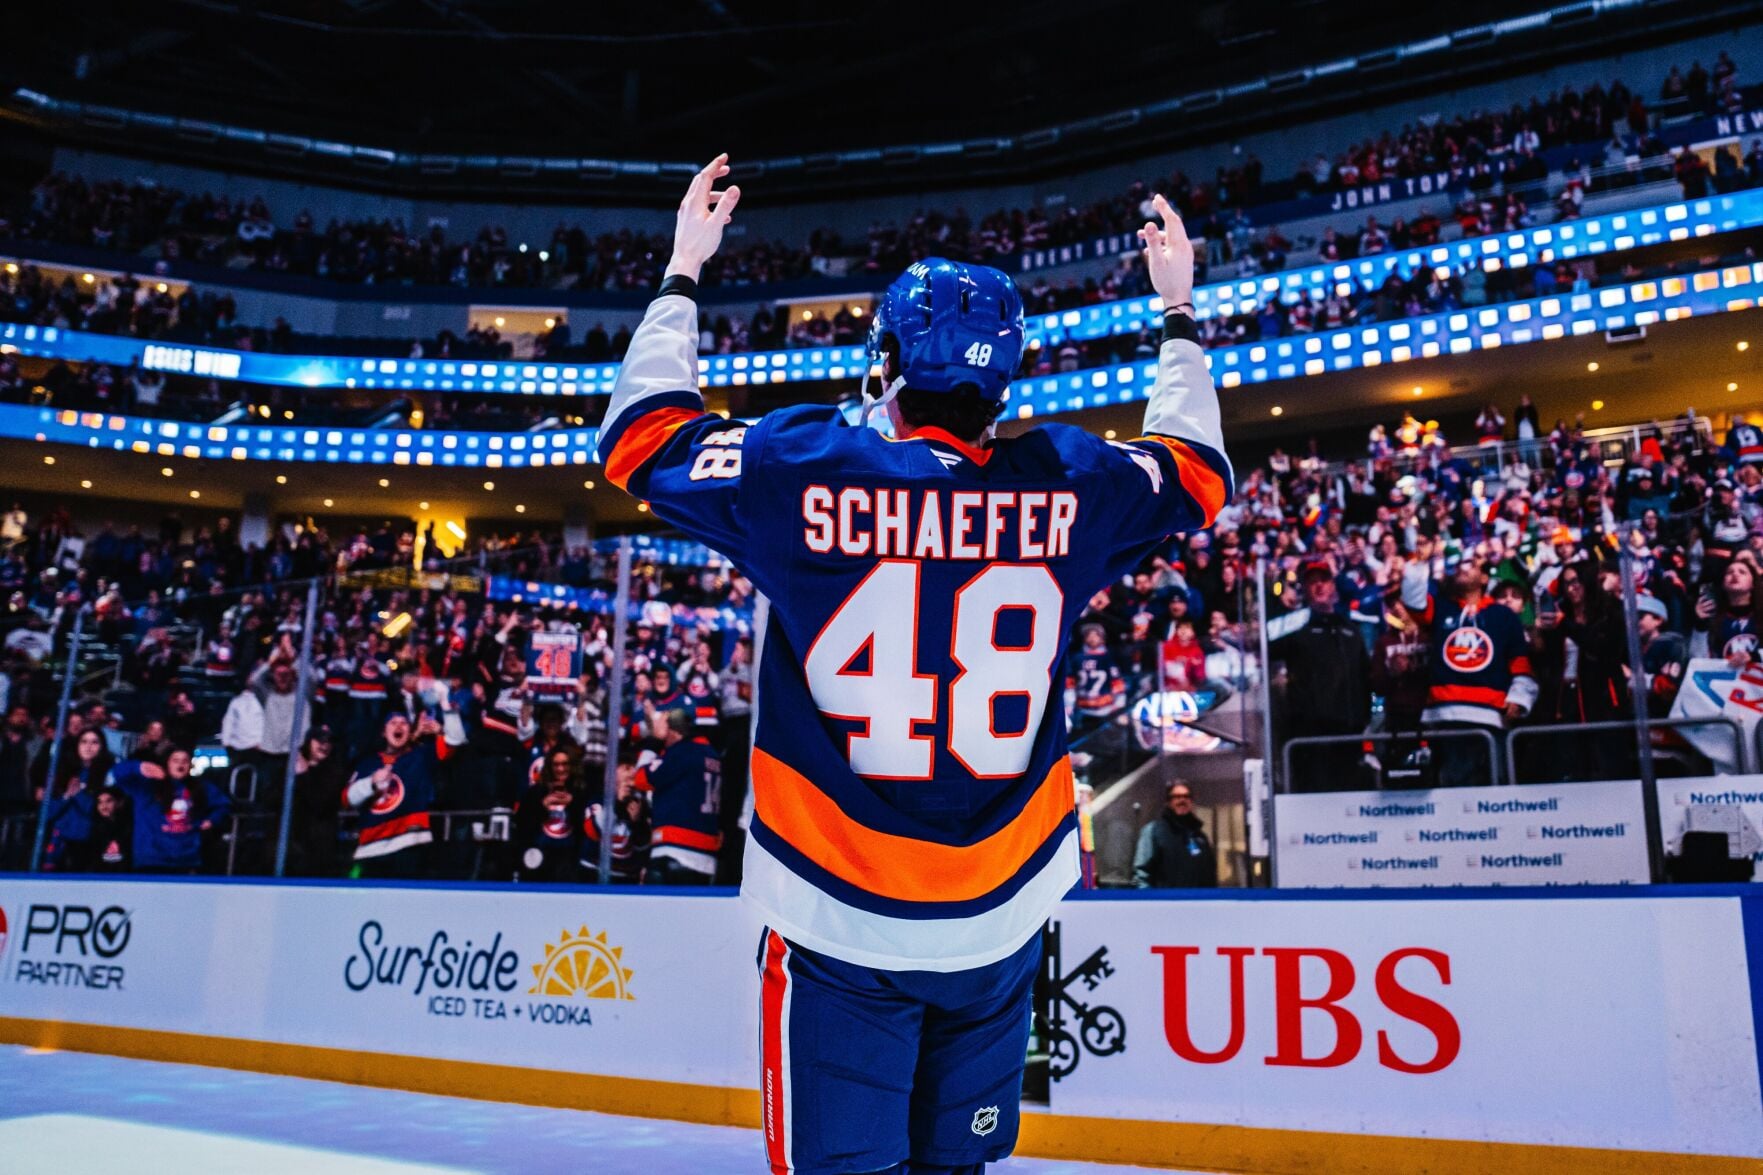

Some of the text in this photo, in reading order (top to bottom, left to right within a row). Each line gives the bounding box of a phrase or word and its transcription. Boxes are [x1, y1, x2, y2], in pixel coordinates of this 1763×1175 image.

[1331, 184, 1391, 210] JOHN
[964, 342, 993, 367] 48
[802, 485, 1078, 559] SCHAEFER
[804, 558, 1064, 781] 48
[1359, 803, 1435, 817] Northwell
[1478, 797, 1558, 813] Northwell
[1303, 831, 1378, 845] Northwell
[1419, 828, 1498, 842] Northwell
[1541, 823, 1625, 839] Northwell
[1361, 856, 1438, 870] Northwell
[1481, 853, 1562, 868] Northwell
[22, 904, 131, 958] PRO
[345, 920, 518, 995] Surfside
[16, 960, 124, 990] PARTNER
[428, 996, 466, 1016] ICED
[474, 998, 507, 1019] TEA
[528, 1003, 592, 1026] VODKA
[1151, 945, 1461, 1074] UBS
[767, 1067, 775, 1142] WARRIOR
